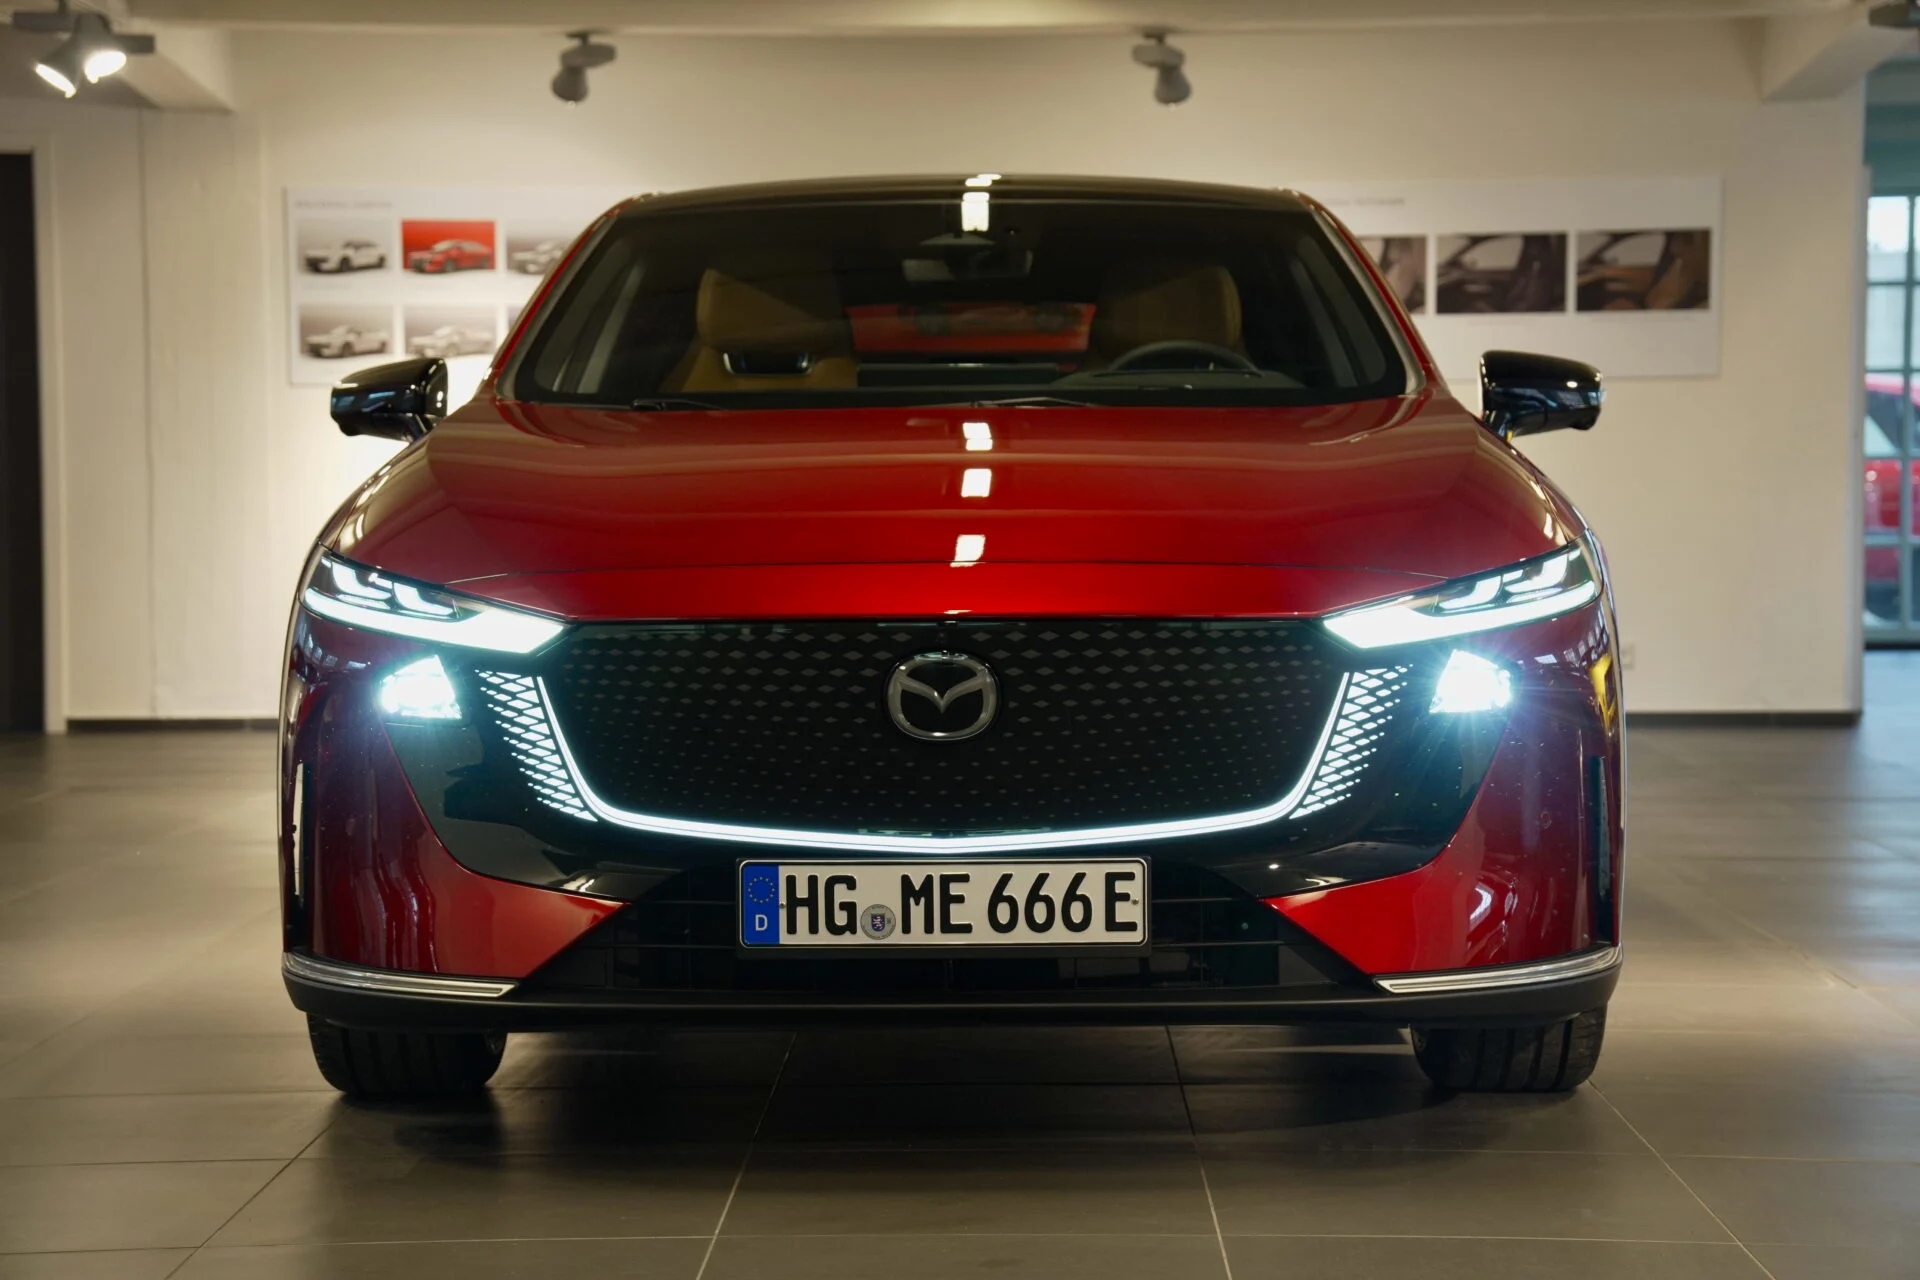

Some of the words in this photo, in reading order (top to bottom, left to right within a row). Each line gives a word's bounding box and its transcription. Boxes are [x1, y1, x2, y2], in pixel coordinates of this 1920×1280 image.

[755, 914, 768, 931] D
[785, 874, 858, 935] HG
[901, 872, 974, 934] ME
